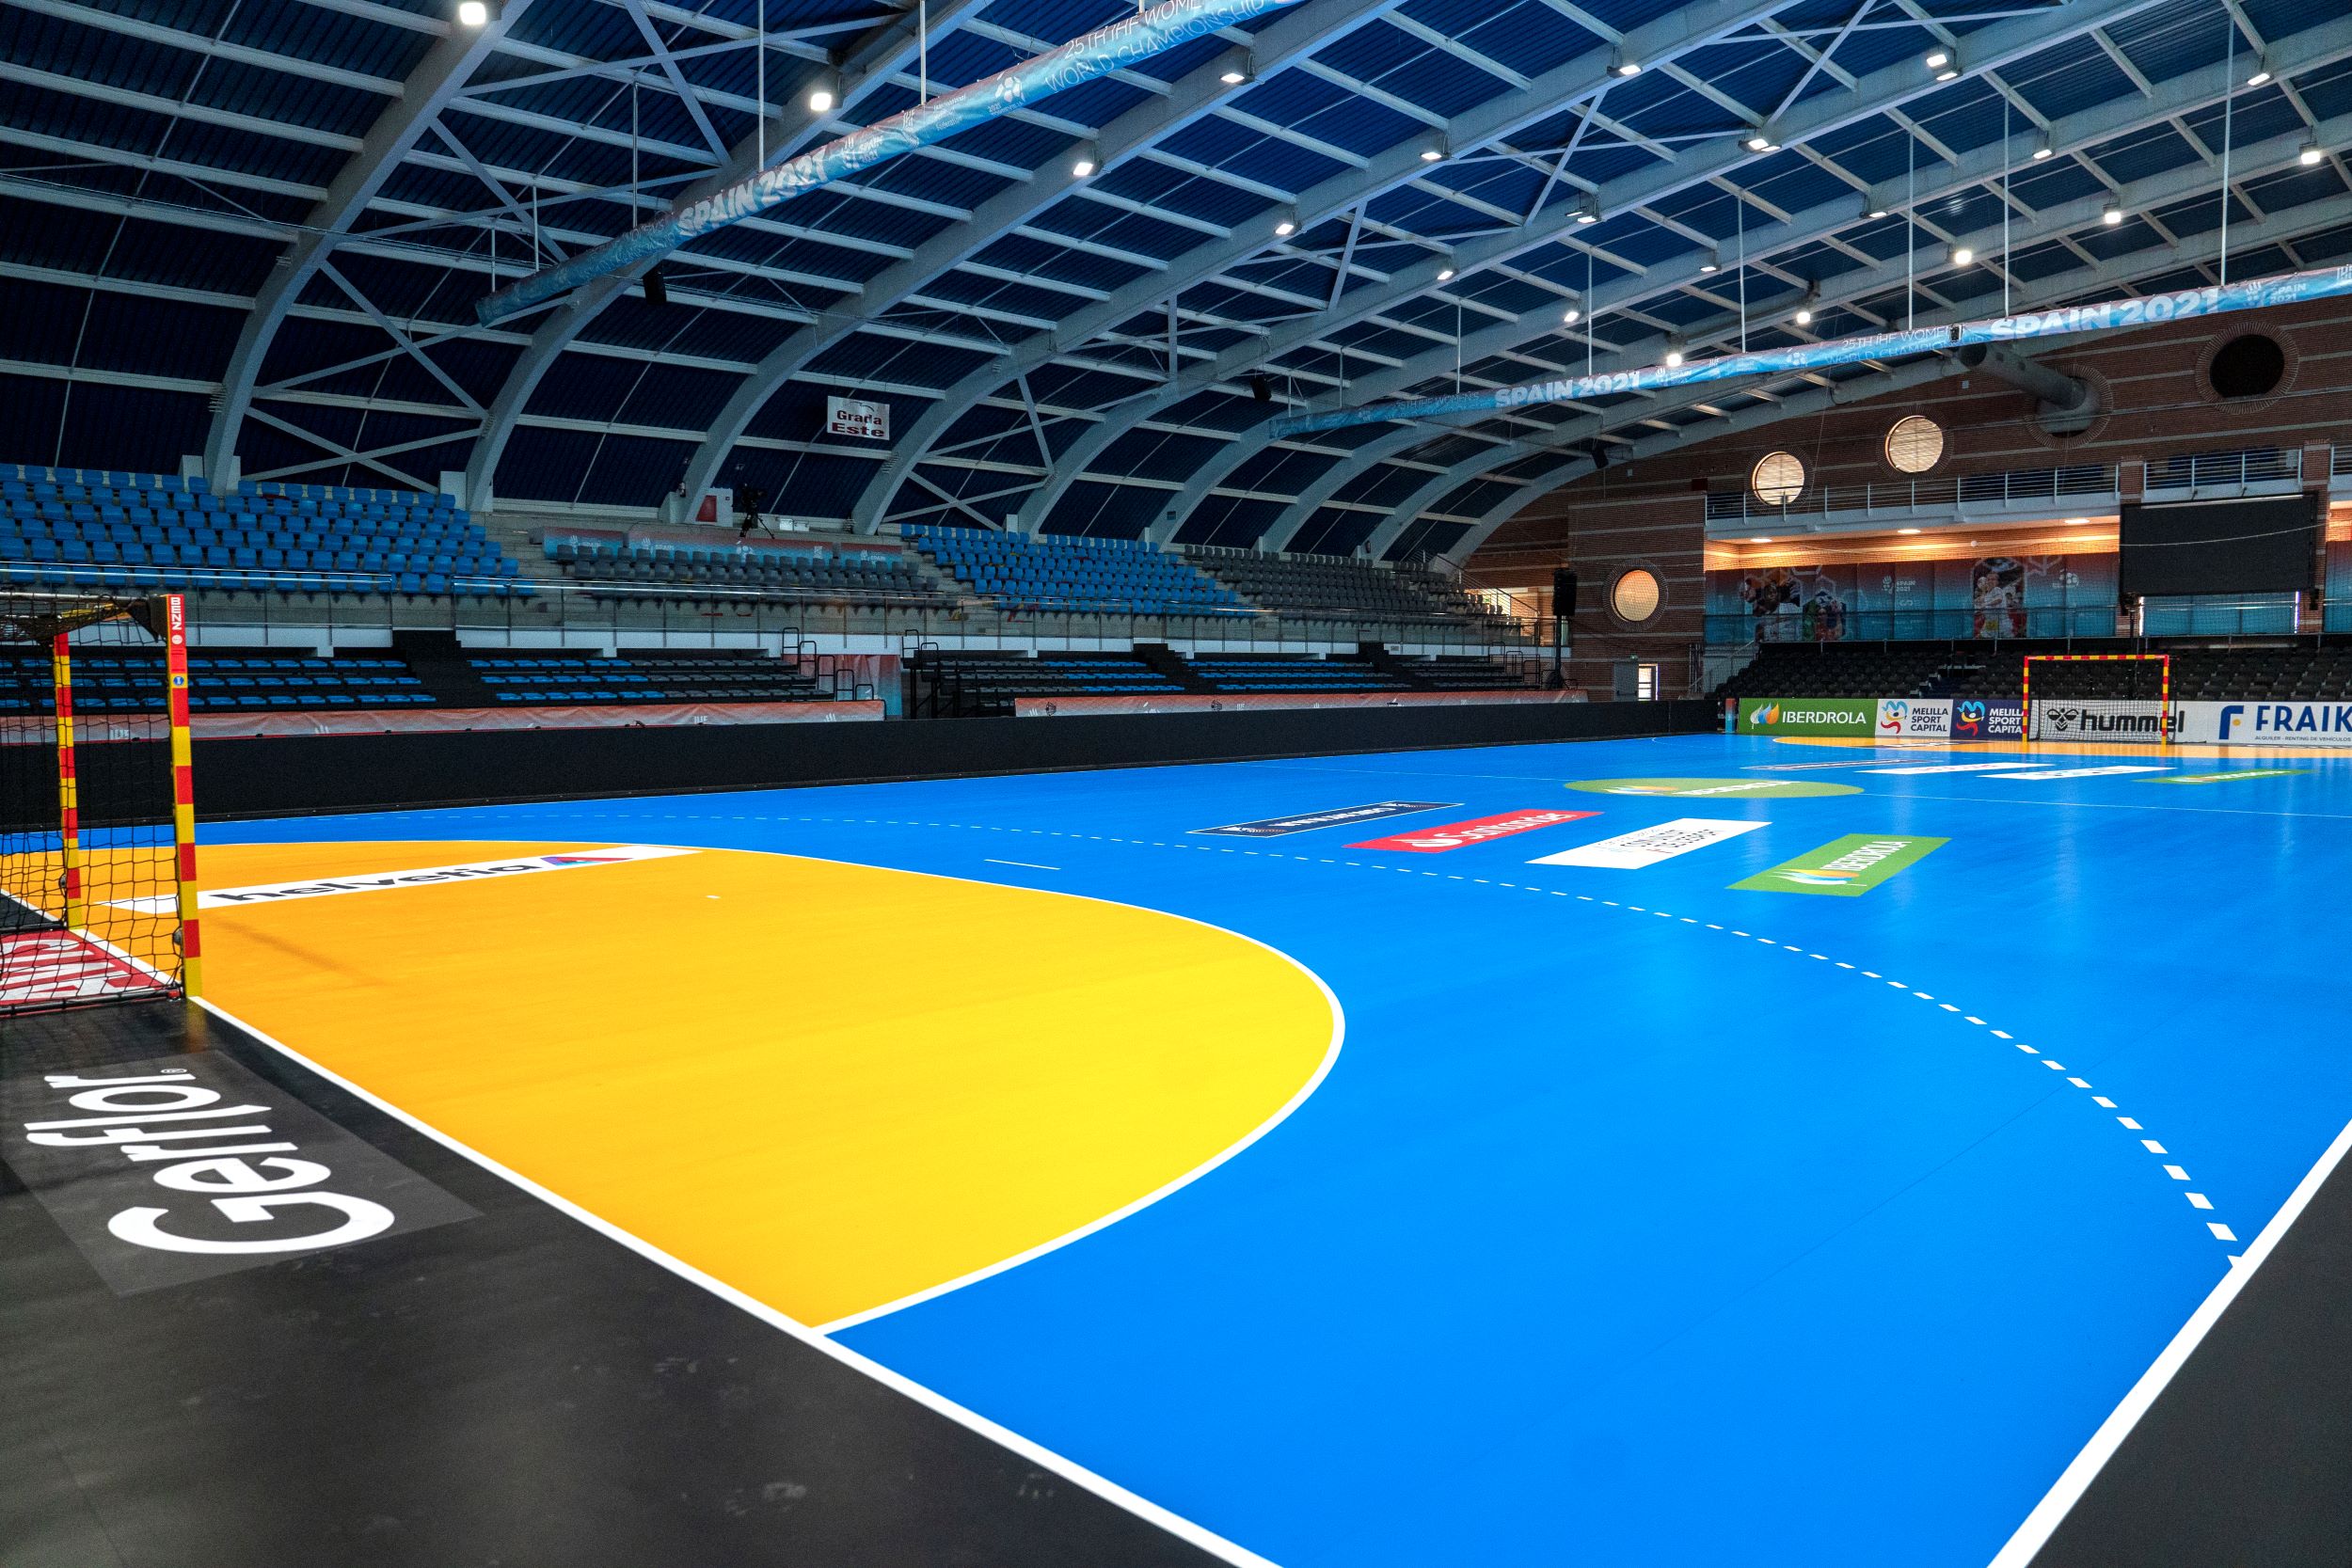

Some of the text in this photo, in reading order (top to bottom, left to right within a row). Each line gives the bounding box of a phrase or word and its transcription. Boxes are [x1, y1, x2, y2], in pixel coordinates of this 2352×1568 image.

[1065, 27, 1106, 59] 25TH
[1111, 15, 1138, 41] IHF
[1045, 54, 1114, 92] WORLD
[677, 145, 829, 237] SPAIN 2021
[1990, 288, 2220, 337] SPAIN 2021
[1842, 338, 1872, 351] 25TH
[1495, 371, 1640, 408] SPAIN 2021
[832, 421, 884, 436] Este
[836, 409, 882, 425] Grada
[170, 596, 183, 630] BENZ
[1782, 711, 1867, 724] IBERDROLA
[1912, 707, 1948, 716] MELILLA
[2080, 709, 2185, 733] hummel
[2256, 705, 2352, 732] FRAIK
[1910, 723, 1947, 732] CAPITAL
[1988, 725, 2024, 734] CAPITA
[1820, 841, 1912, 871] IBERDROLA
[211, 863, 542, 901] helvetia
[24, 1072, 395, 1254] Gerflor
